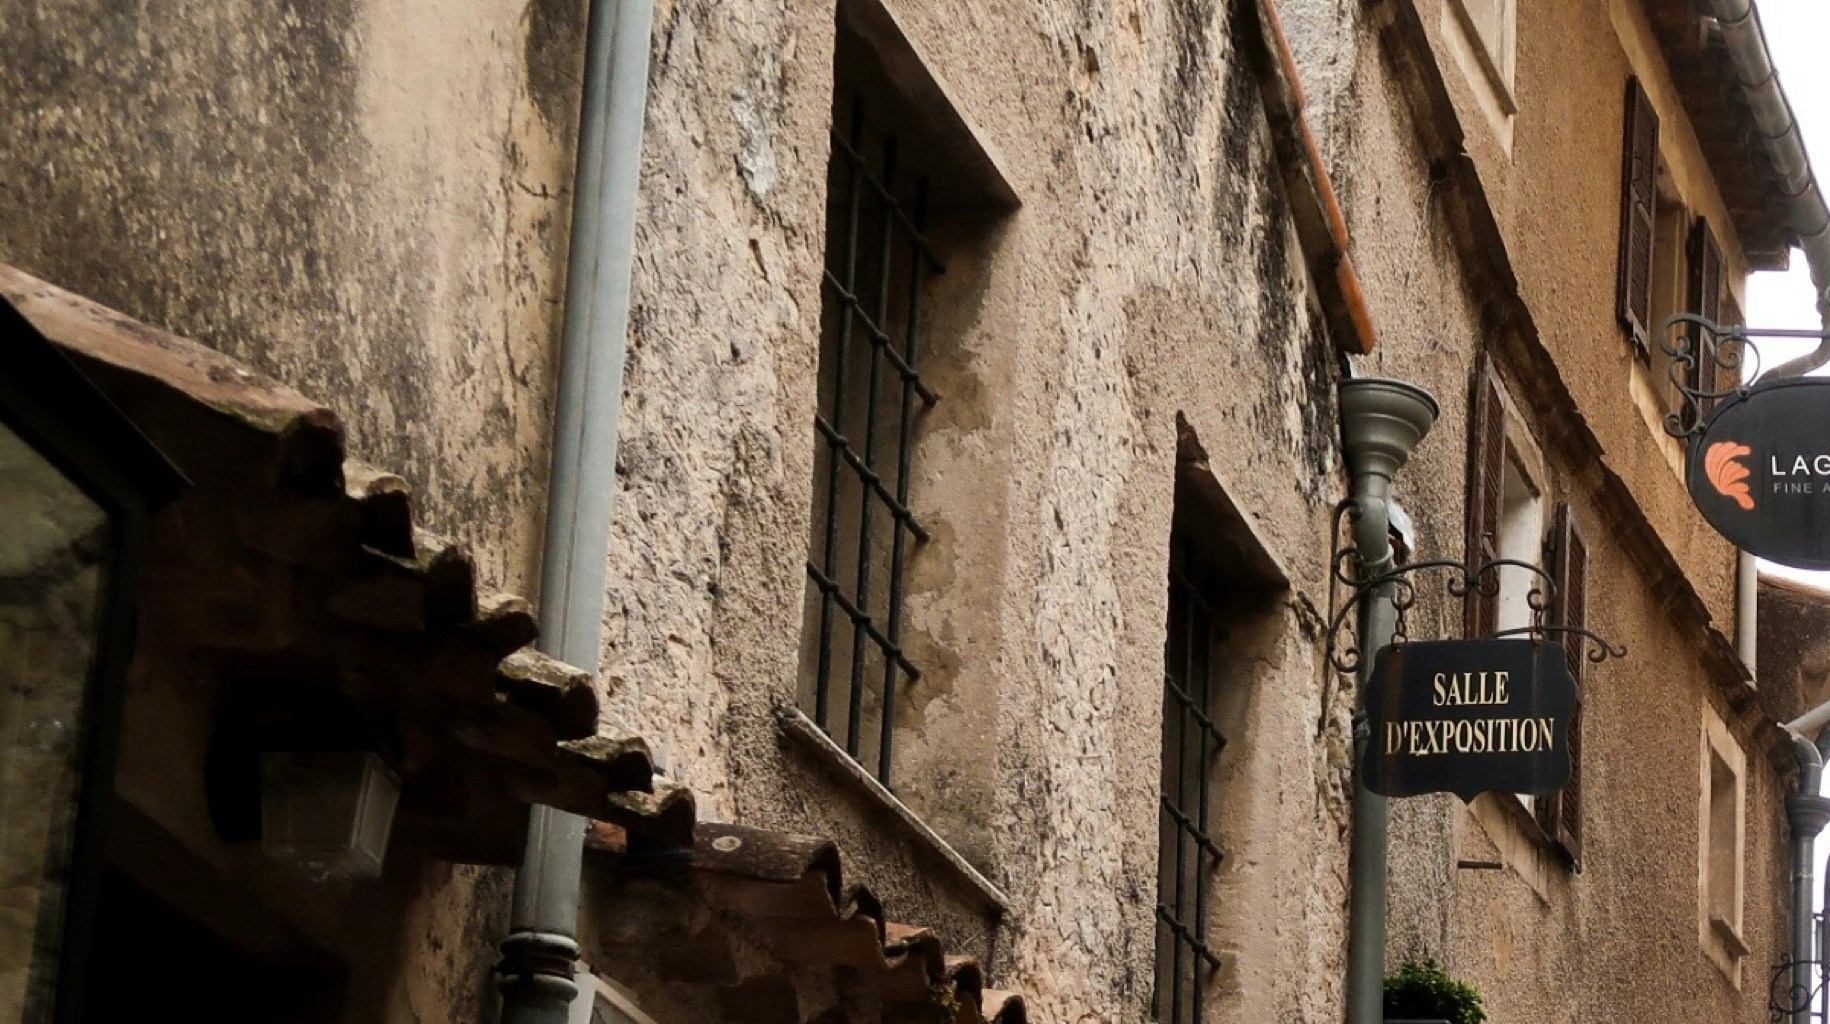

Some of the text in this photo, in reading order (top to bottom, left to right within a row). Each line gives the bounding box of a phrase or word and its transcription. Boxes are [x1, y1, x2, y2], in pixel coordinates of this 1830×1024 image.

[1773, 482, 1813, 494] FINE
[1433, 671, 1509, 706] SALLE
[1384, 718, 1555, 756] D'EXPOSITION
